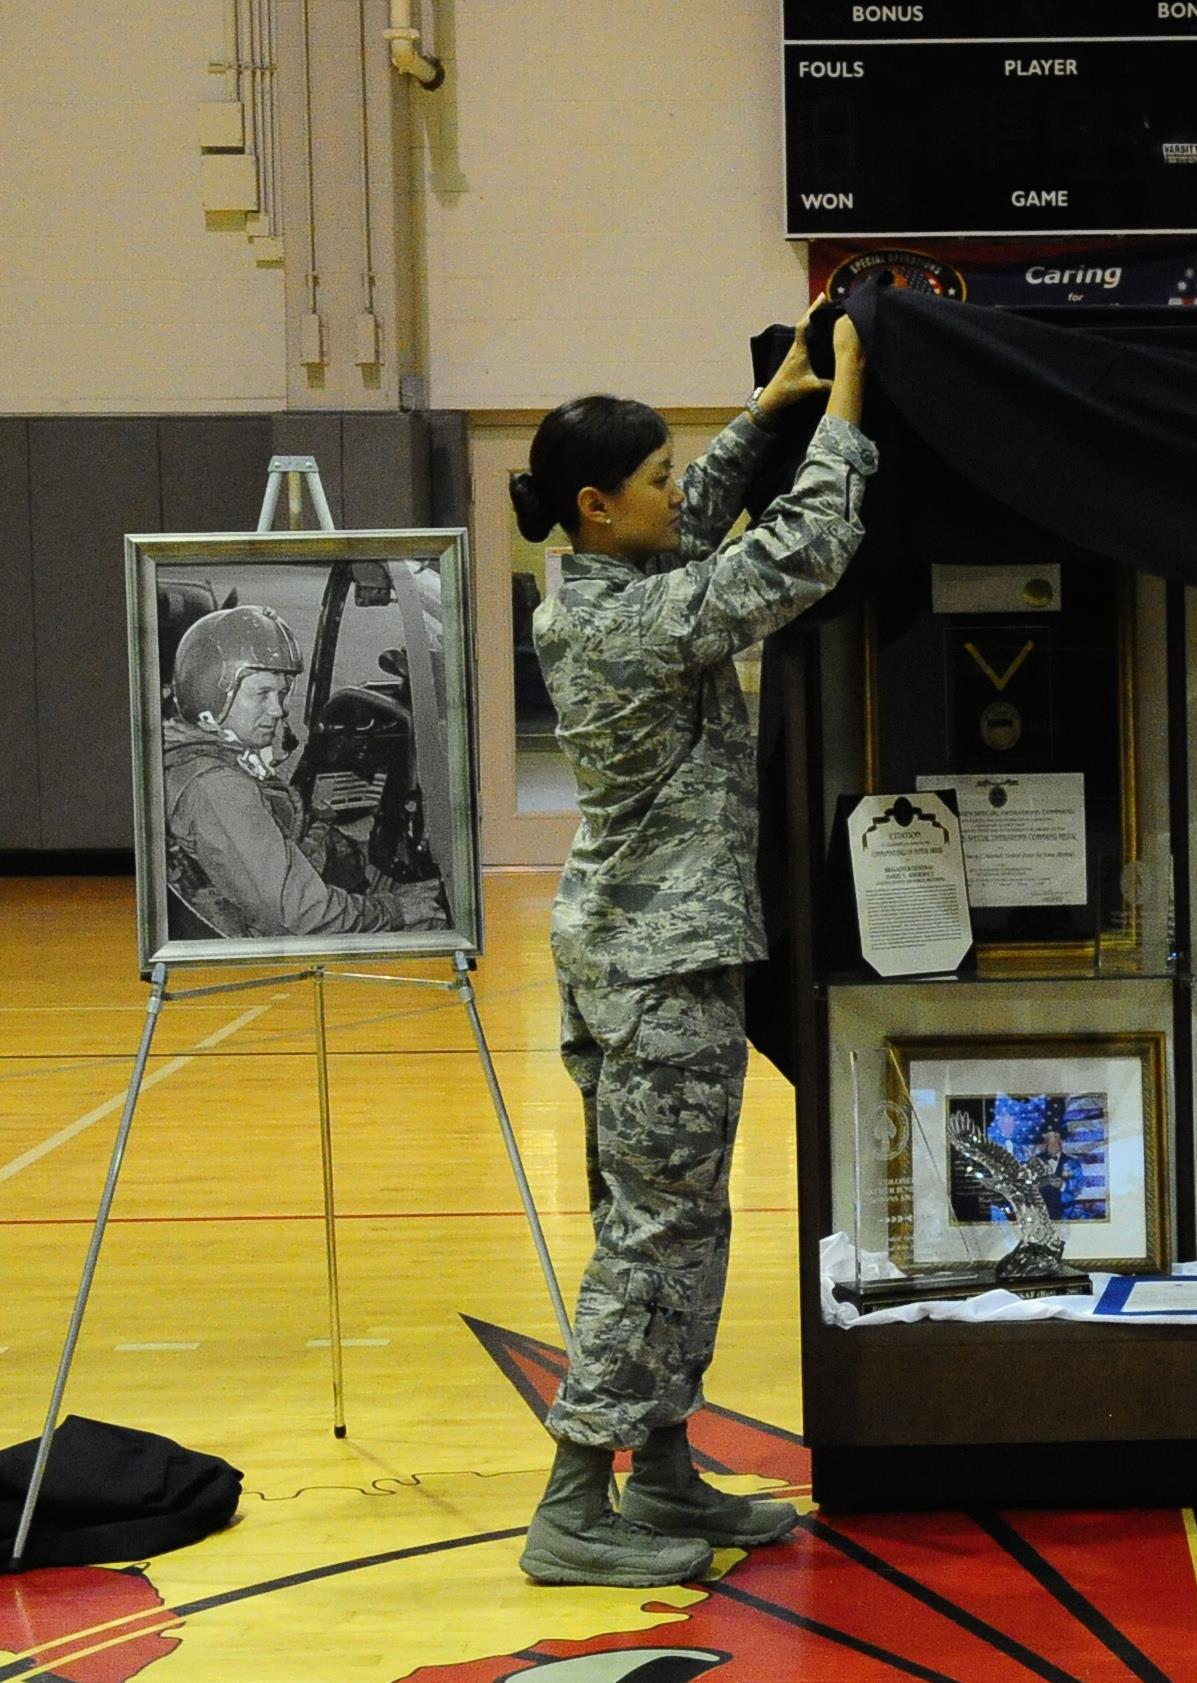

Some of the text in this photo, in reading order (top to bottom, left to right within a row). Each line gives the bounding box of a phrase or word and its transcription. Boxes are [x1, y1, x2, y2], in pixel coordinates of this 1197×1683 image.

[853, 5, 924, 22] BONUS
[799, 61, 864, 78] FOULS
[1004, 59, 1078, 76] PLAYER
[801, 193, 854, 210] WON
[1011, 190, 1068, 207] GAME
[849, 254, 886, 275] SPECIAL
[1025, 265, 1122, 289] Caring
[1068, 292, 1084, 302] for
